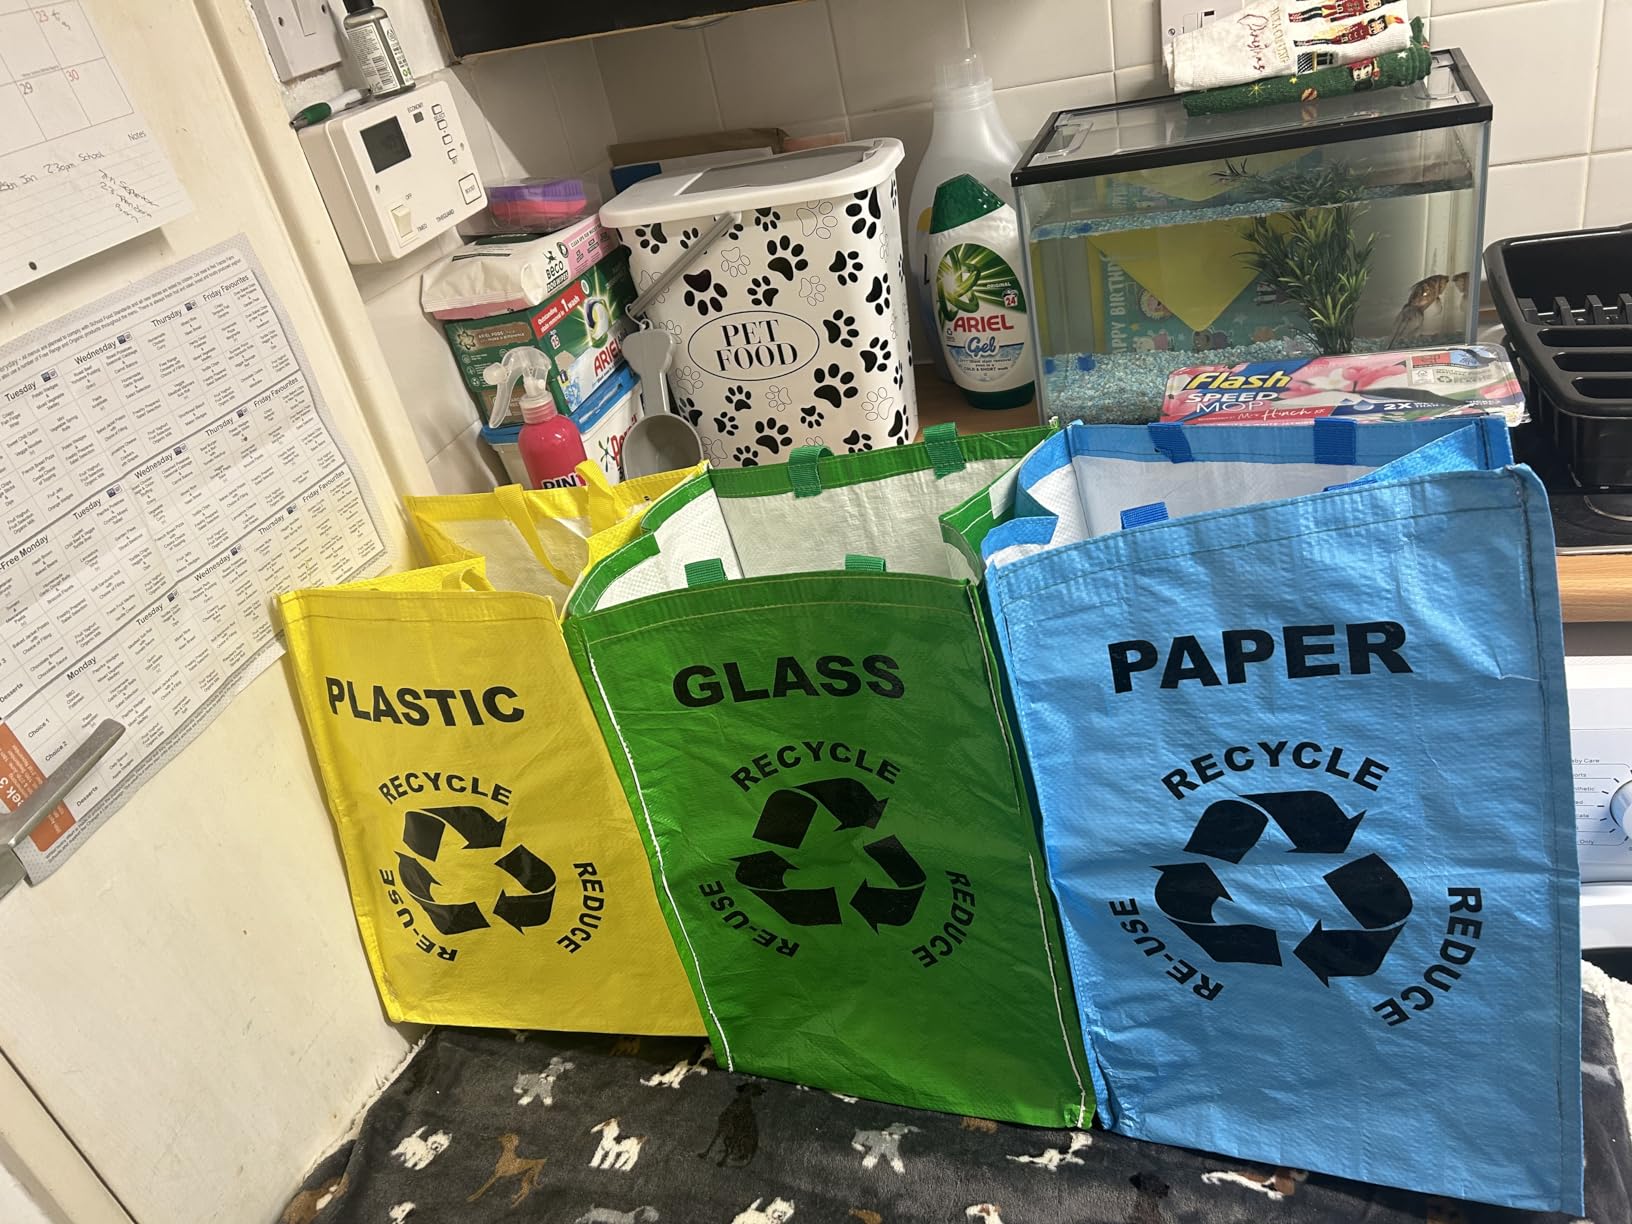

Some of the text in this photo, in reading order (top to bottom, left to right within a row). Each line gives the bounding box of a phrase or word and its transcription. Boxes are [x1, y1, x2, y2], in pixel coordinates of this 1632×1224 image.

[19, 81, 34, 95] 29
[66, 69, 80, 82] 30
[128, 130, 147, 142] Notes
[4, 275, 249, 401] Tuesday Wednesday Thursday Friday Favourites
[720, 319, 780, 348] PET
[953, 314, 1015, 334] ARIEL
[714, 342, 798, 372] FOOD
[967, 335, 996, 357] Gel
[1184, 370, 1292, 391] Flash
[1185, 391, 1279, 403] SPEED
[1195, 401, 1265, 413] MOP
[19, 535, 48, 557] Monday
[73, 499, 101, 519] Tuesday
[134, 453, 172, 478] Wednesday
[204, 417, 233, 436] Thursday
[251, 394, 271, 407] Friday
[269, 377, 298, 396] Favourites
[67, 657, 96, 680] Monday
[136, 604, 163, 625] Tuesday
[194, 554, 230, 581] Wednesday
[256, 515, 284, 534] Thursday
[300, 489, 319, 502] Friday
[316, 470, 344, 490] Favourites
[1107, 620, 1414, 694] PAPER
[0, 683, 23, 702] Desserts
[672, 654, 905, 708] GLASS
[325, 676, 525, 727] PLASTIC
[28, 722, 46, 738] Choice
[45, 745, 63, 761] Choice
[729, 740, 901, 793] RECYCLE
[1160, 740, 1390, 800] RECYCLE
[76, 786, 98, 806] Desserts
[378, 771, 513, 806] RECYCLE
[378, 868, 459, 962] RE-USE
[556, 861, 605, 954] REDUCE
[698, 879, 800, 959] RE-USE
[910, 869, 976, 969] REDUCE
[1108, 897, 1225, 1001] RE-USE
[1372, 886, 1484, 1027] REDUCE
